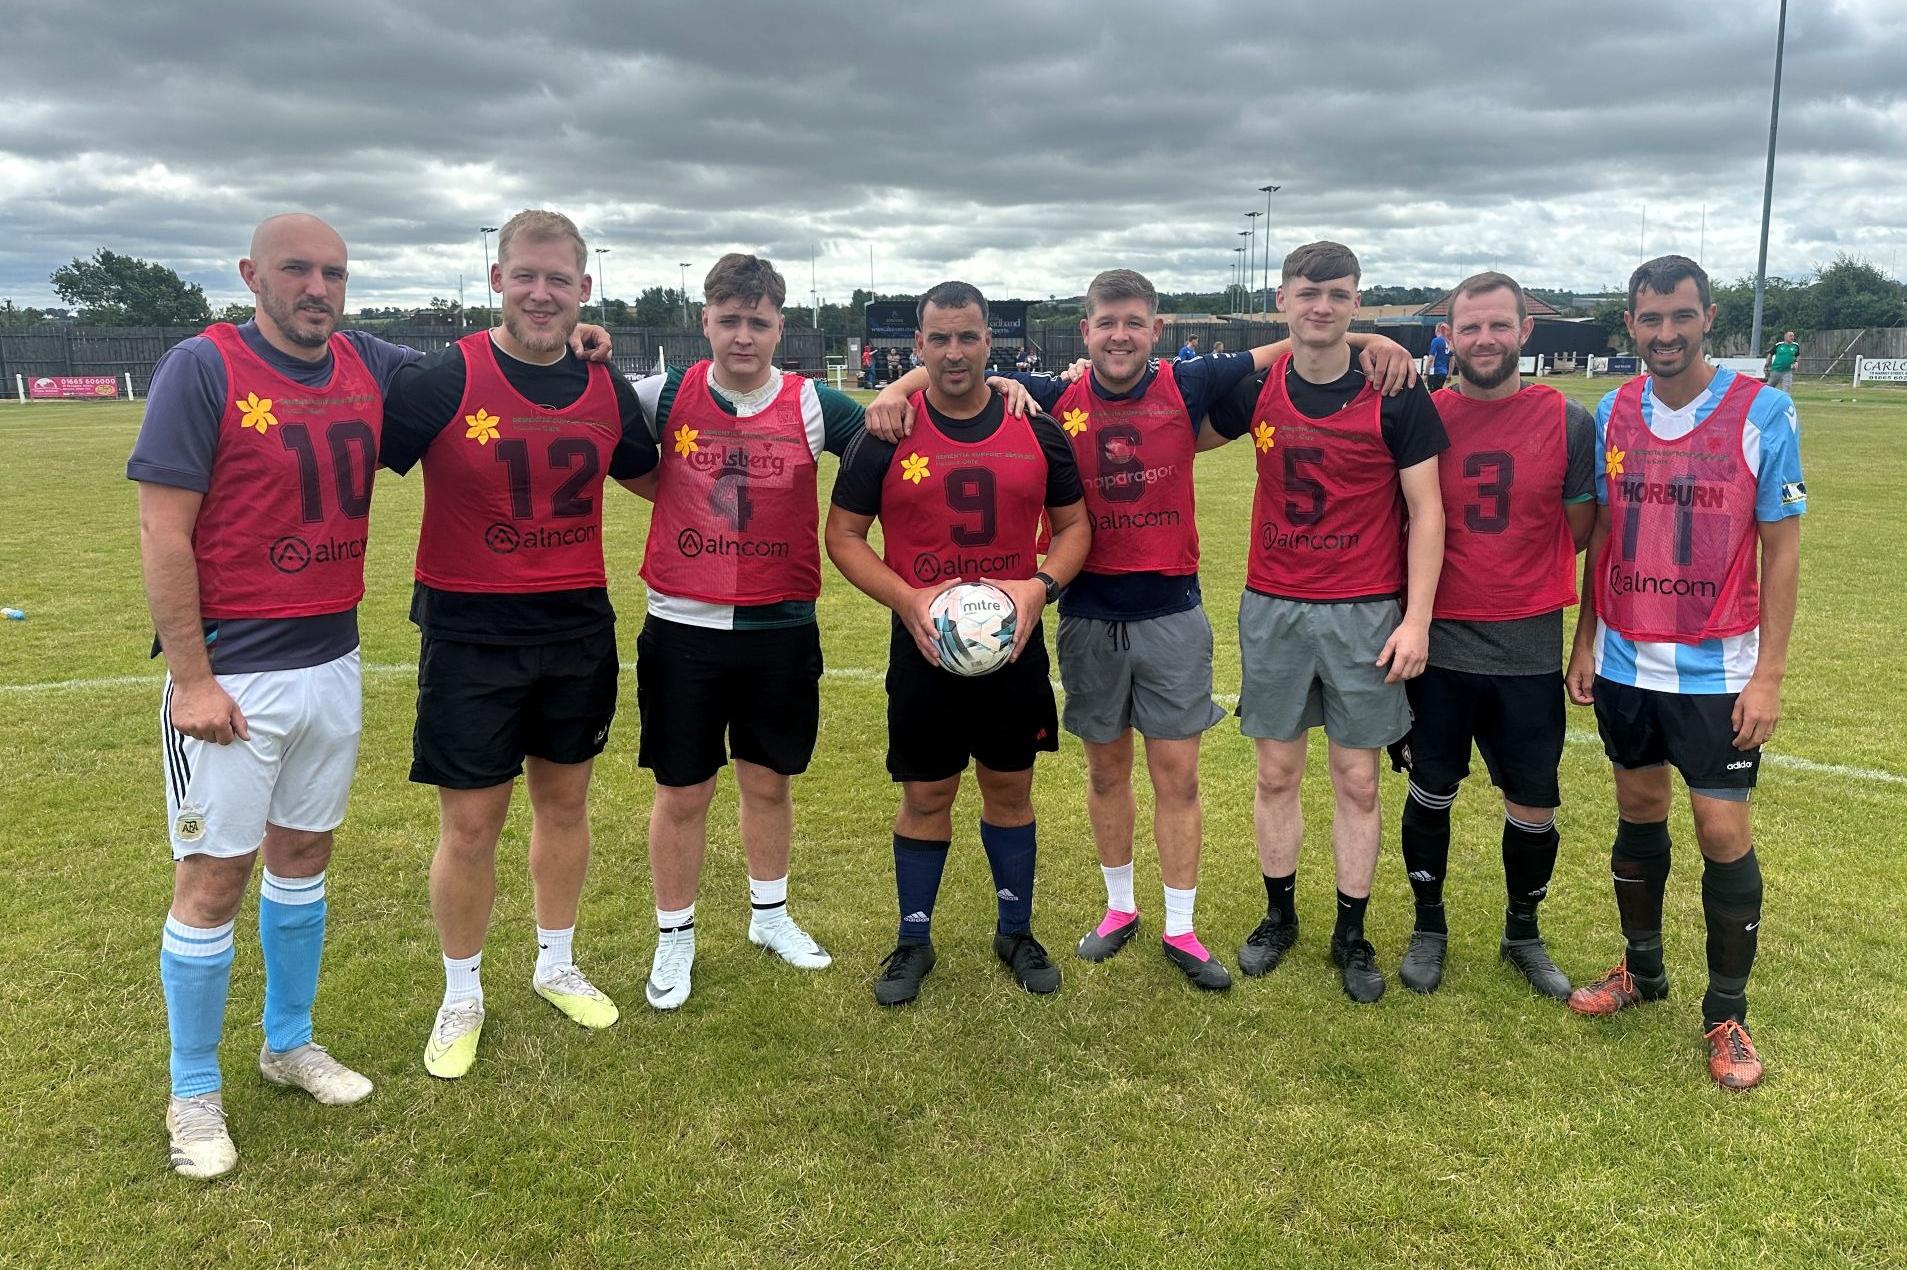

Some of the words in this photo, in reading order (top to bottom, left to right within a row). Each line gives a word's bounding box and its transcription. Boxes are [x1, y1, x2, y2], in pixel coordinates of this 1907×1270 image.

[279, 418, 377, 524] 10
[495, 437, 599, 521] 12
[686, 436, 785, 479] Carlsberg
[1083, 464, 1178, 490] napdragon
[1096, 424, 1146, 503] 6
[708, 448, 753, 532] 4
[944, 466, 997, 547] 9
[1283, 446, 1325, 527] 5
[1463, 451, 1514, 534] 3
[1616, 481, 1725, 509] THORBURN
[1100, 509, 1180, 530] alncom
[1279, 528, 1360, 550] alncom
[1621, 472, 1698, 566] 11
[705, 534, 789, 558] alncom
[943, 553, 1020, 576] alncom
[1622, 570, 1717, 598] alncom
[963, 600, 1001, 613] mitre
